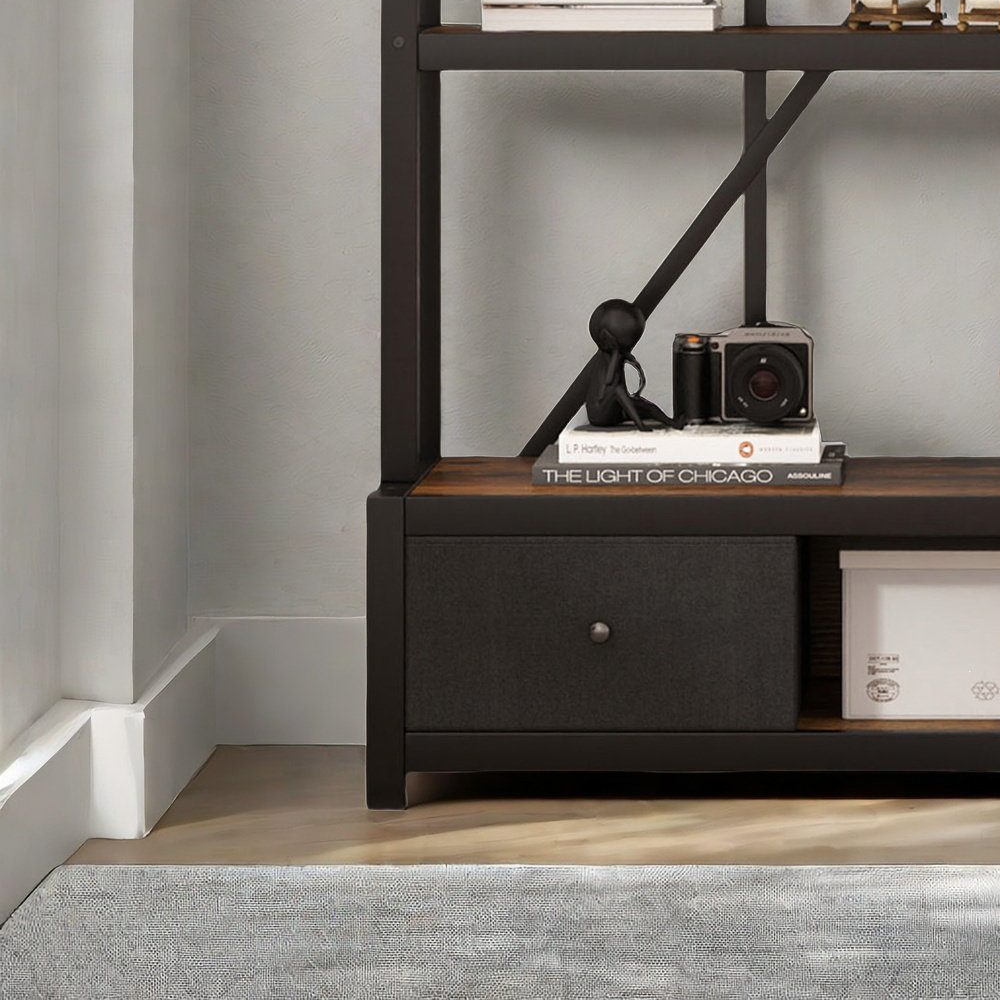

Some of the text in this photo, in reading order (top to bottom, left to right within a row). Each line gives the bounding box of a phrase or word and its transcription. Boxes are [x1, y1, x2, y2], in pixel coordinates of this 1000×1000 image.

[542, 469, 773, 483] THE LIGHT OF CHICAGO
[787, 472, 832, 480] ASSOULINE
